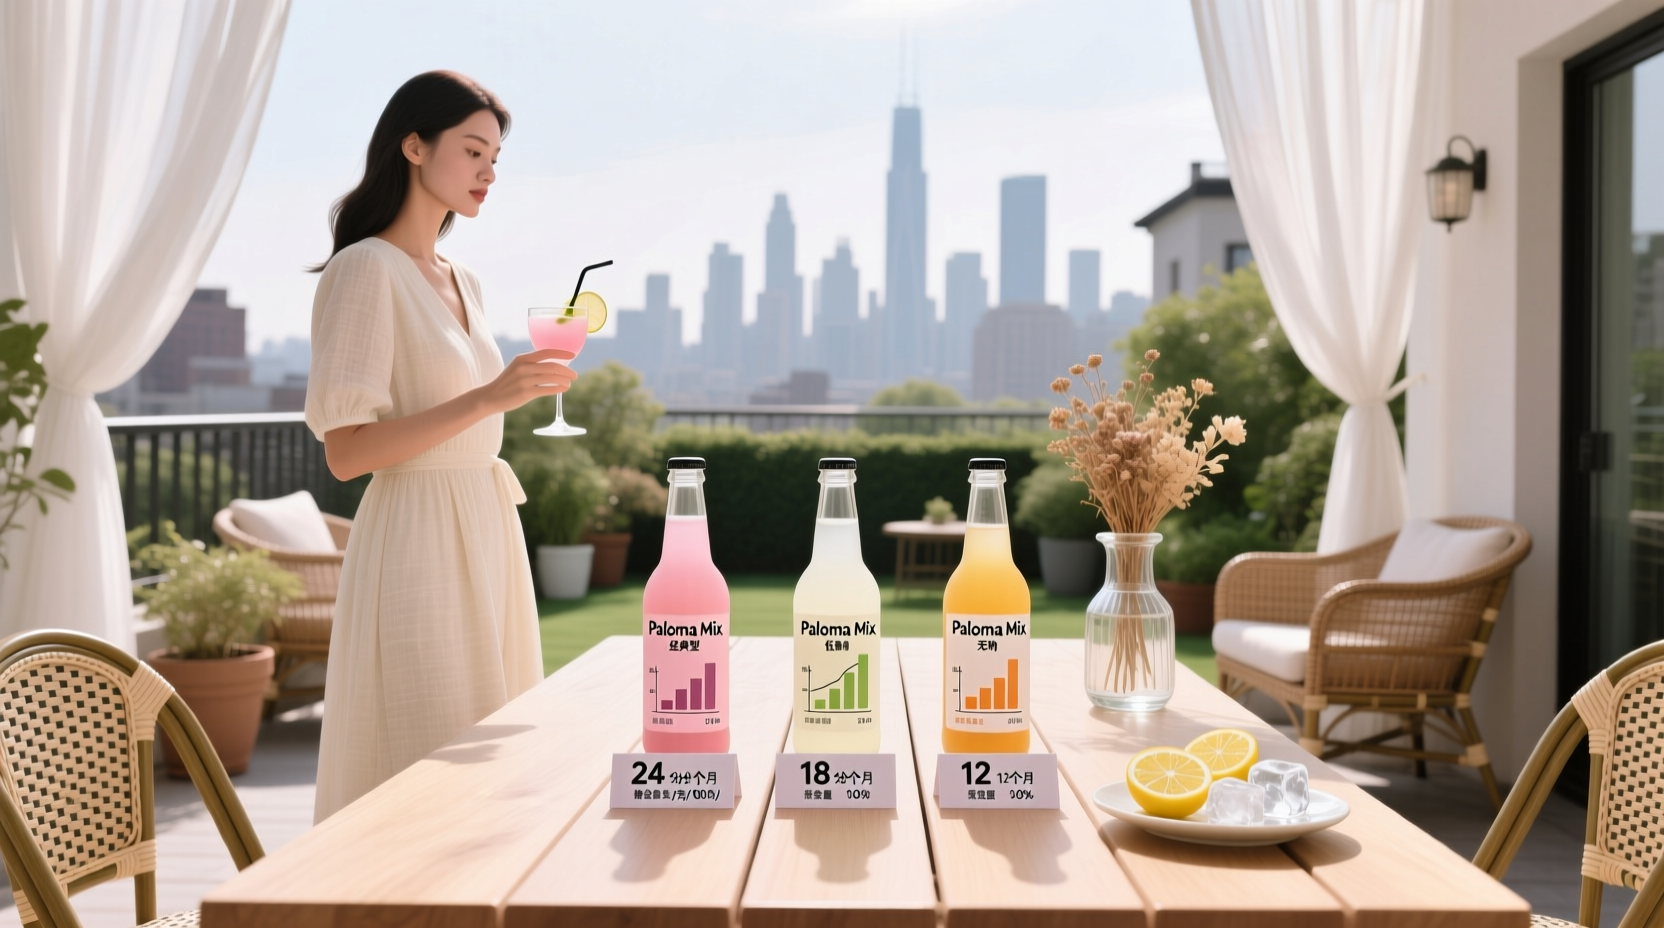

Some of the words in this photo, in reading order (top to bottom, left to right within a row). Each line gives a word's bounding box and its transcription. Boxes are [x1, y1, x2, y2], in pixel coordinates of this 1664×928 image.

[649, 620, 697, 636] Paloma
[700, 621, 723, 636] Mix
[801, 621, 851, 636] Paloma
[854, 621, 876, 636] Mix
[952, 620, 1003, 636] Paloma
[1006, 621, 1027, 636] Mix
[631, 761, 665, 785] 24
[800, 761, 830, 785] 18
[961, 761, 991, 785] 12
